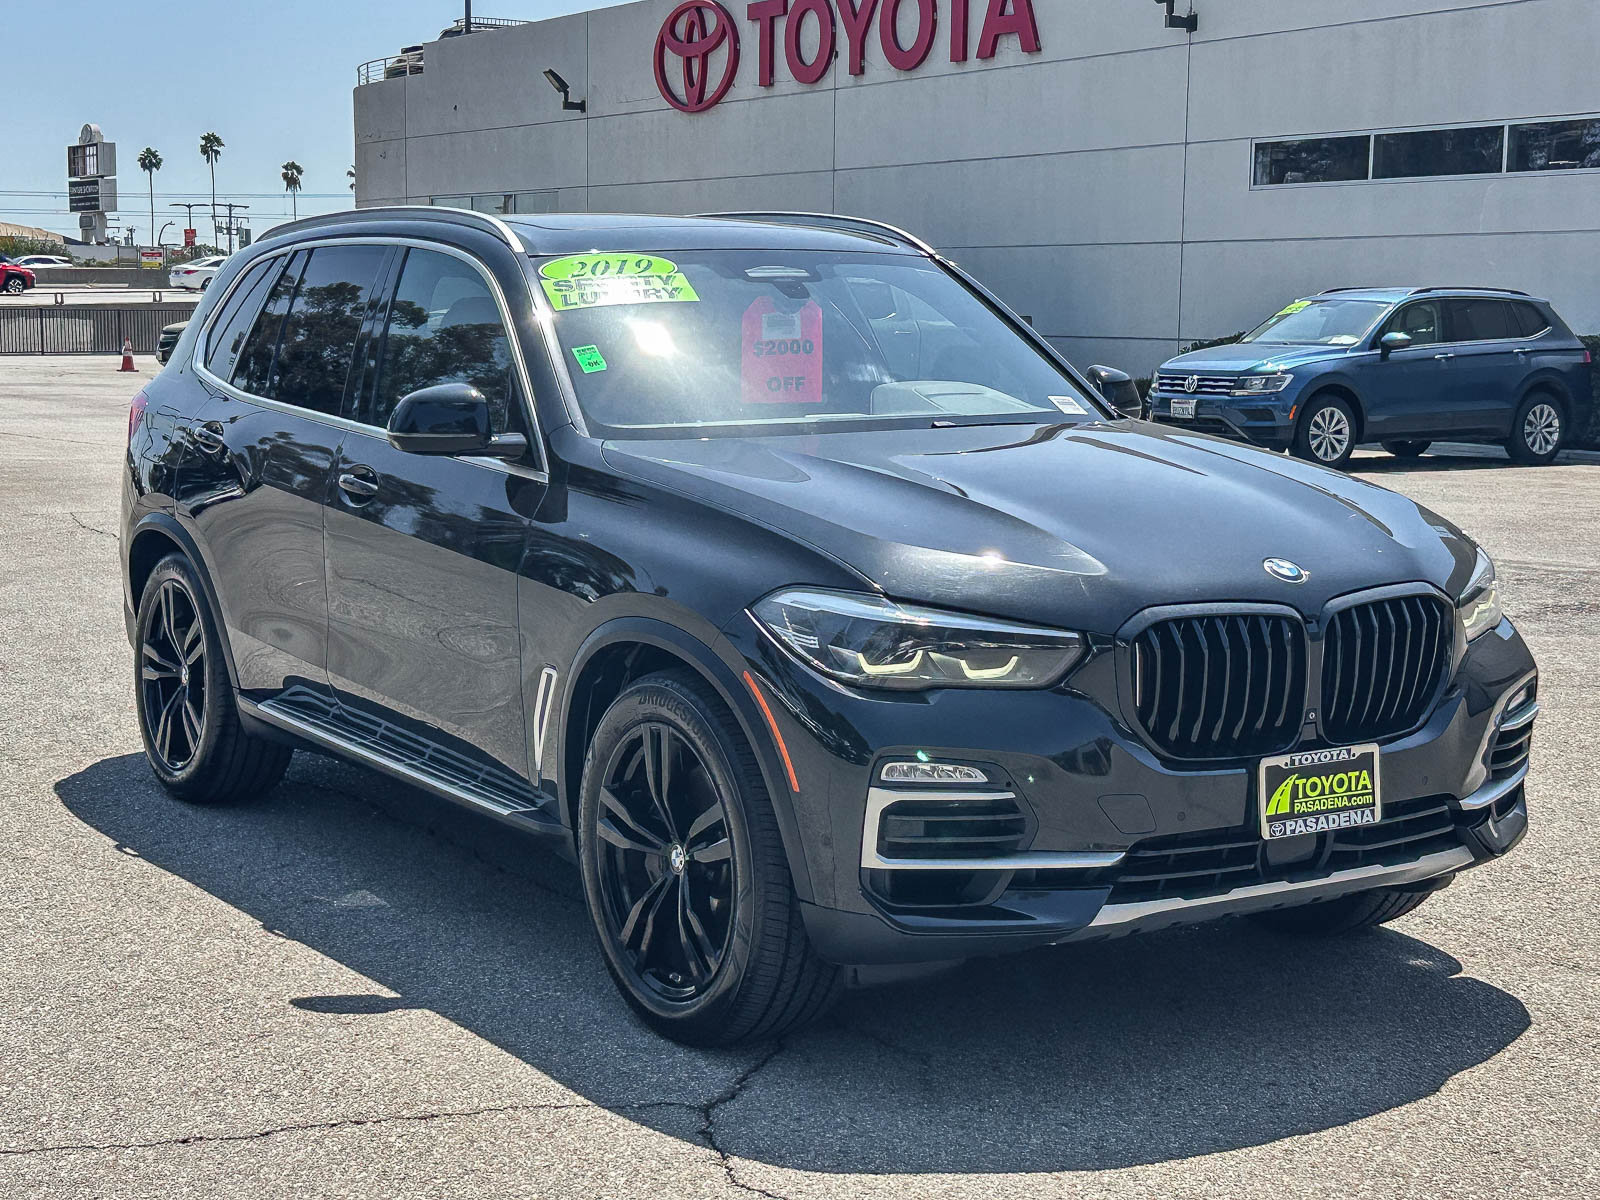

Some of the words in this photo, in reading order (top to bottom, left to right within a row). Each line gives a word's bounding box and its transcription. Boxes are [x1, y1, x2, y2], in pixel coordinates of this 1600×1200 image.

[570, 258, 654, 279] 2019
[752, 339, 815, 358] $2000
[766, 375, 806, 393] OFF
[1293, 750, 1349, 765] TOYOTA
[1295, 770, 1372, 798] TOYOTA
[1293, 794, 1373, 815] PASADENA.com
[1285, 809, 1375, 835] PASADENA
